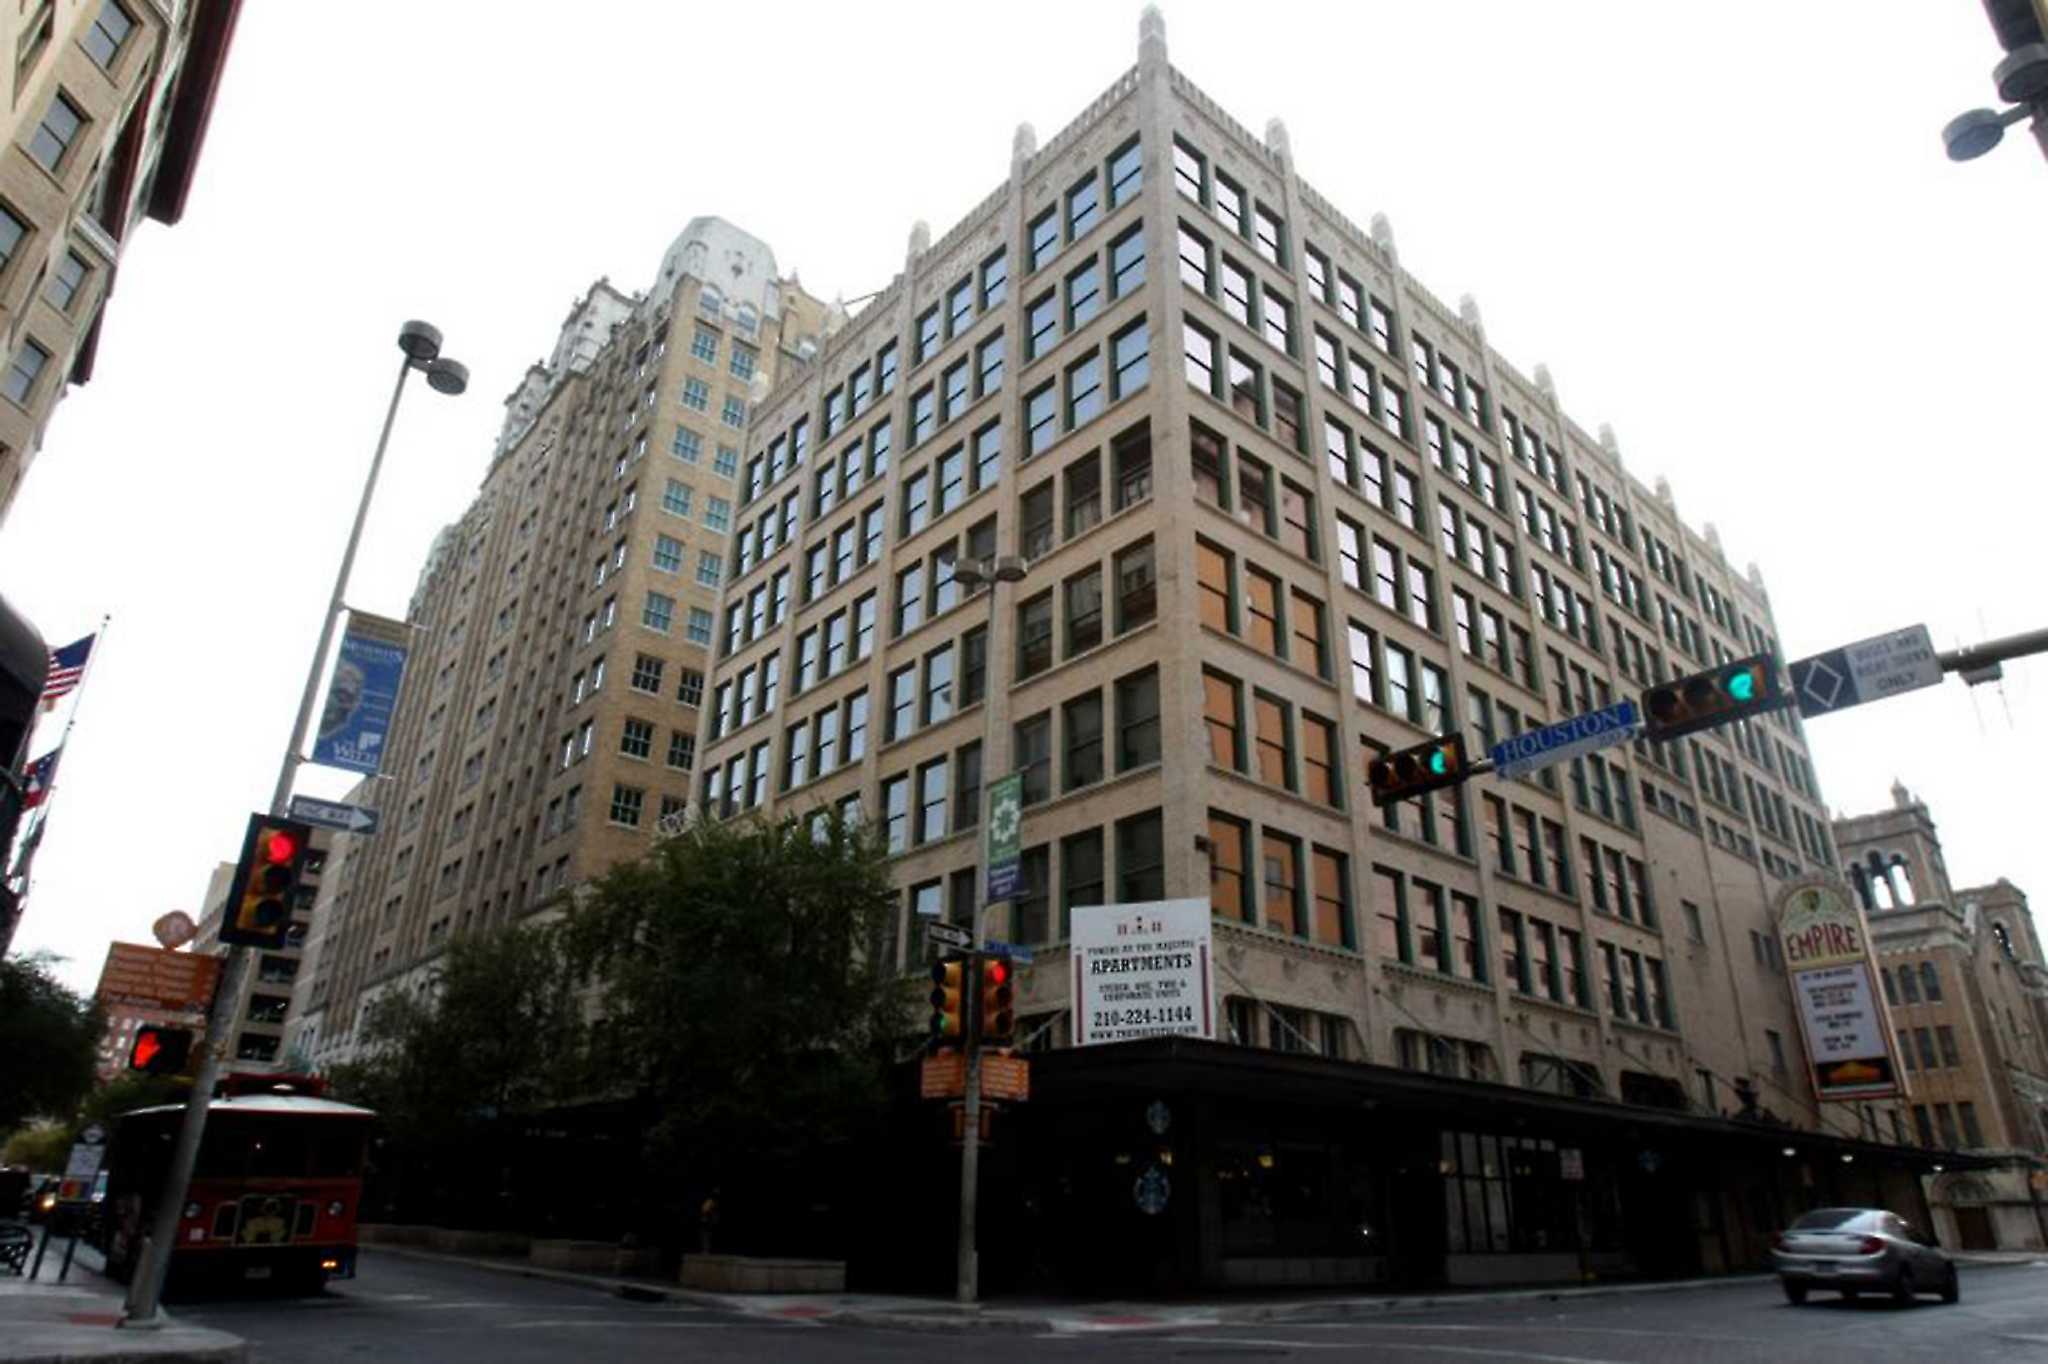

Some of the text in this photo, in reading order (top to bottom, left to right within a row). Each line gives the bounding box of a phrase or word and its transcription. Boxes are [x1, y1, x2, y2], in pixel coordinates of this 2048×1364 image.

[1877, 671, 1916, 691] ONLY
[1502, 709, 1620, 761] HOUSTON
[1786, 922, 1860, 961] EMPIRE
[1091, 953, 1193, 975] APARTMENTS
[1094, 1005, 1192, 1028] 210-224-1144
